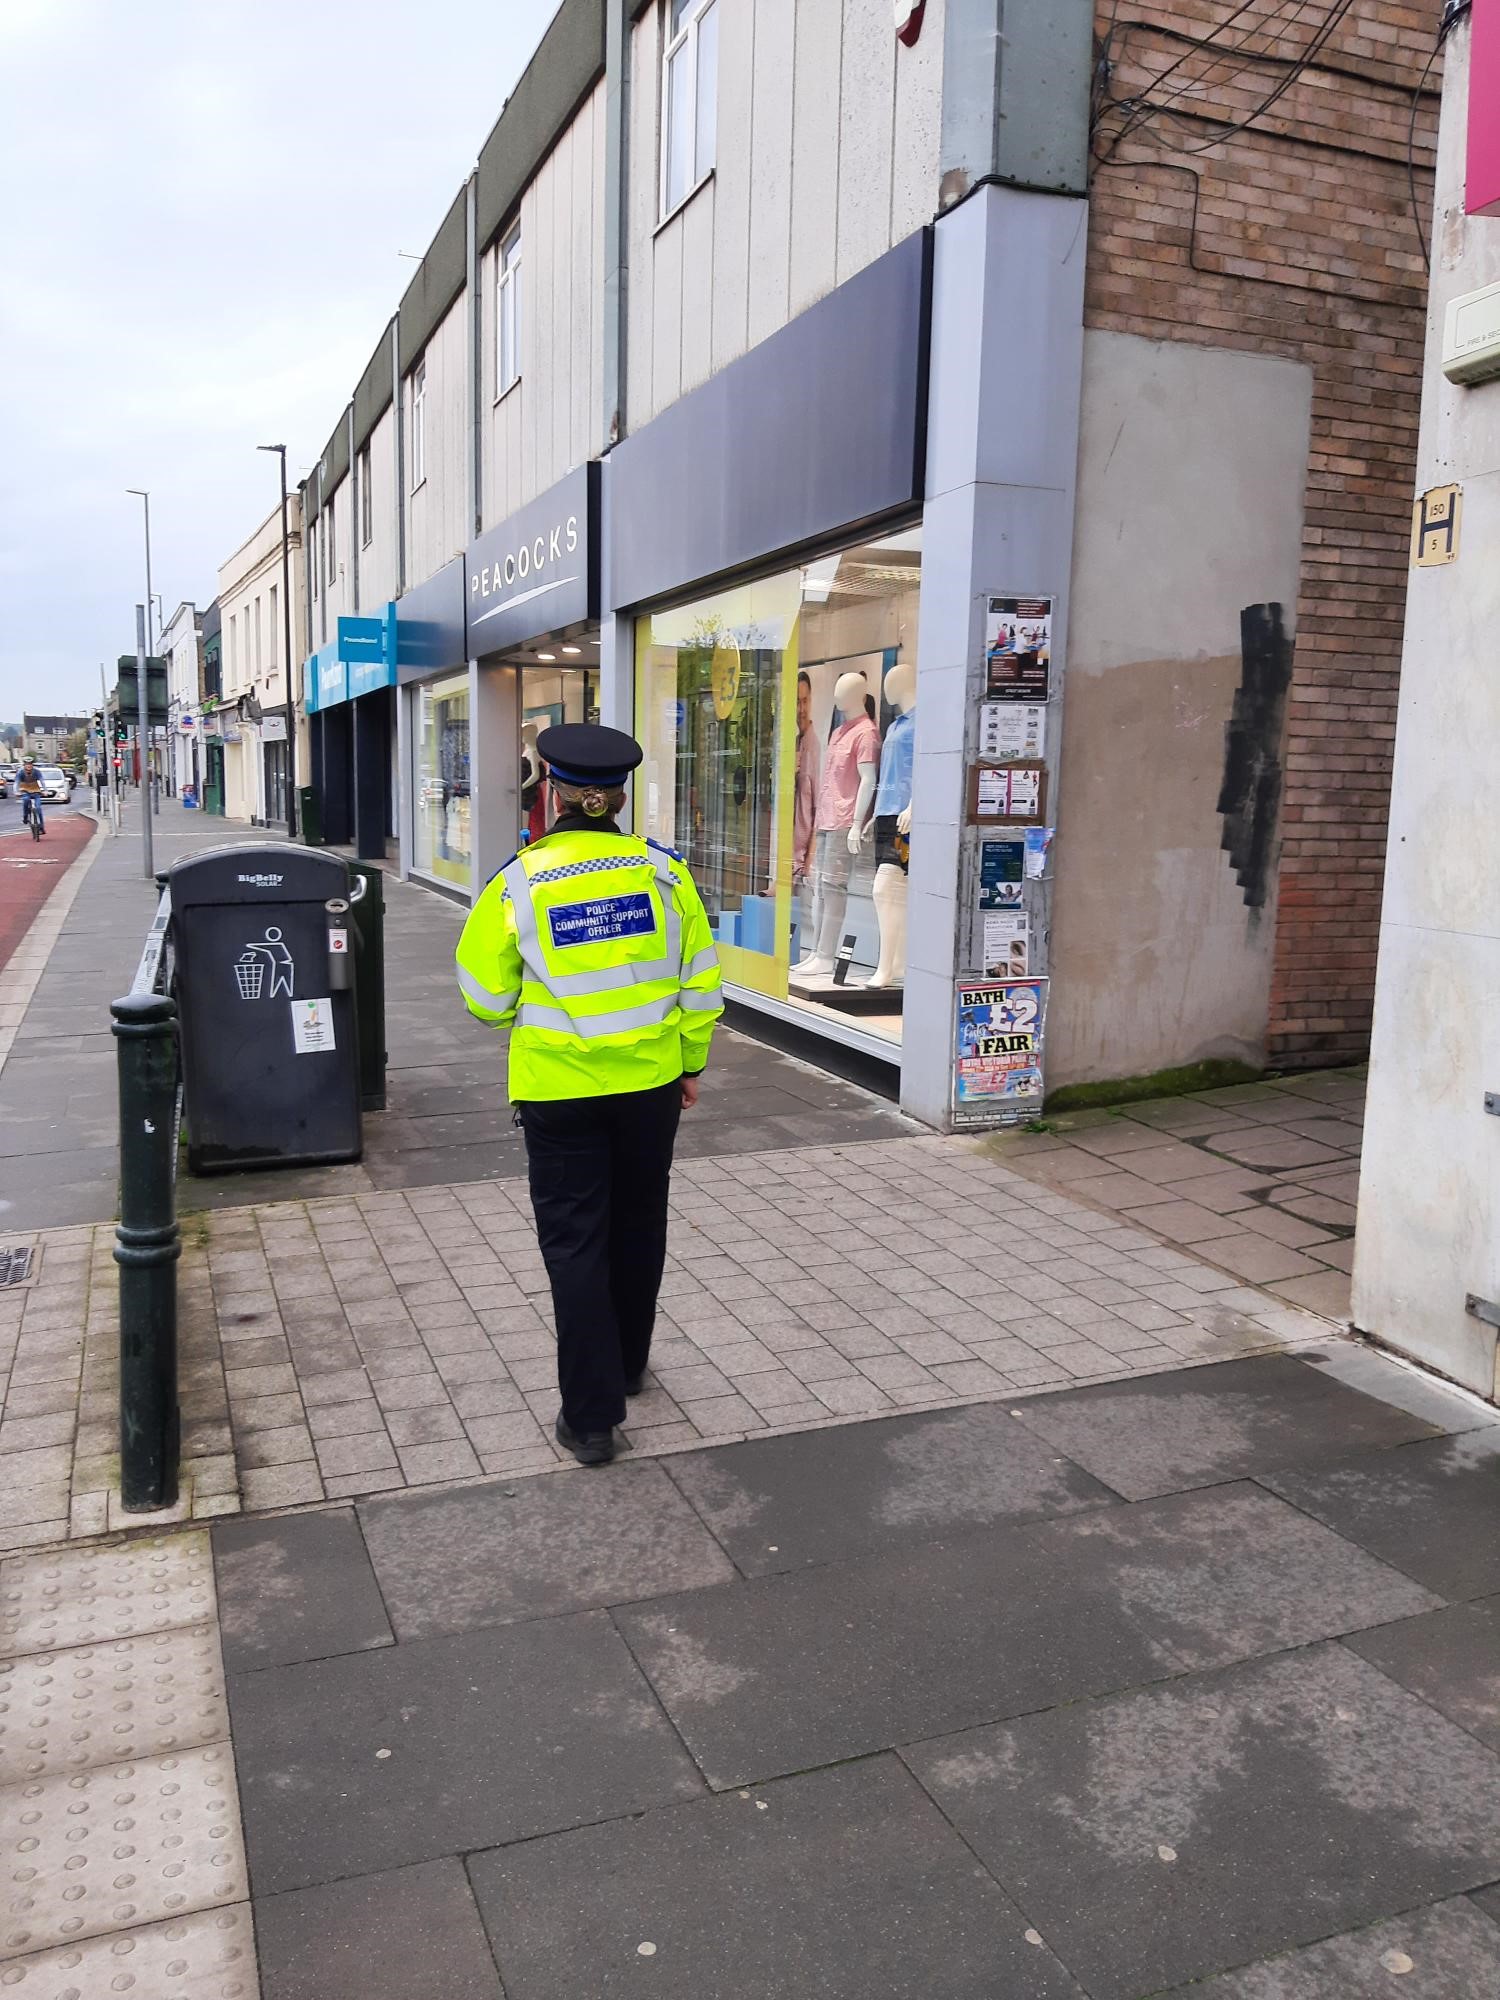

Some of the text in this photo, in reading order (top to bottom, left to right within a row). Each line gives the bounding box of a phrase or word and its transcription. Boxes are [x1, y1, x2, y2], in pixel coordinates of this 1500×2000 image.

[1430, 503, 1445, 517] 150
[1418, 492, 1456, 558] H
[1431, 539, 1438, 551] 5
[471, 516, 578, 602] PEACOCKS
[238, 873, 284, 883] BigBelly
[586, 902, 616, 916] POLICE
[555, 908, 649, 932] COMMUNITY SUPPORT
[588, 923, 622, 937] OFFICER
[962, 990, 1005, 1006] BATH
[987, 998, 1038, 1034] £2
[982, 1035, 1030, 1054] FAIR
